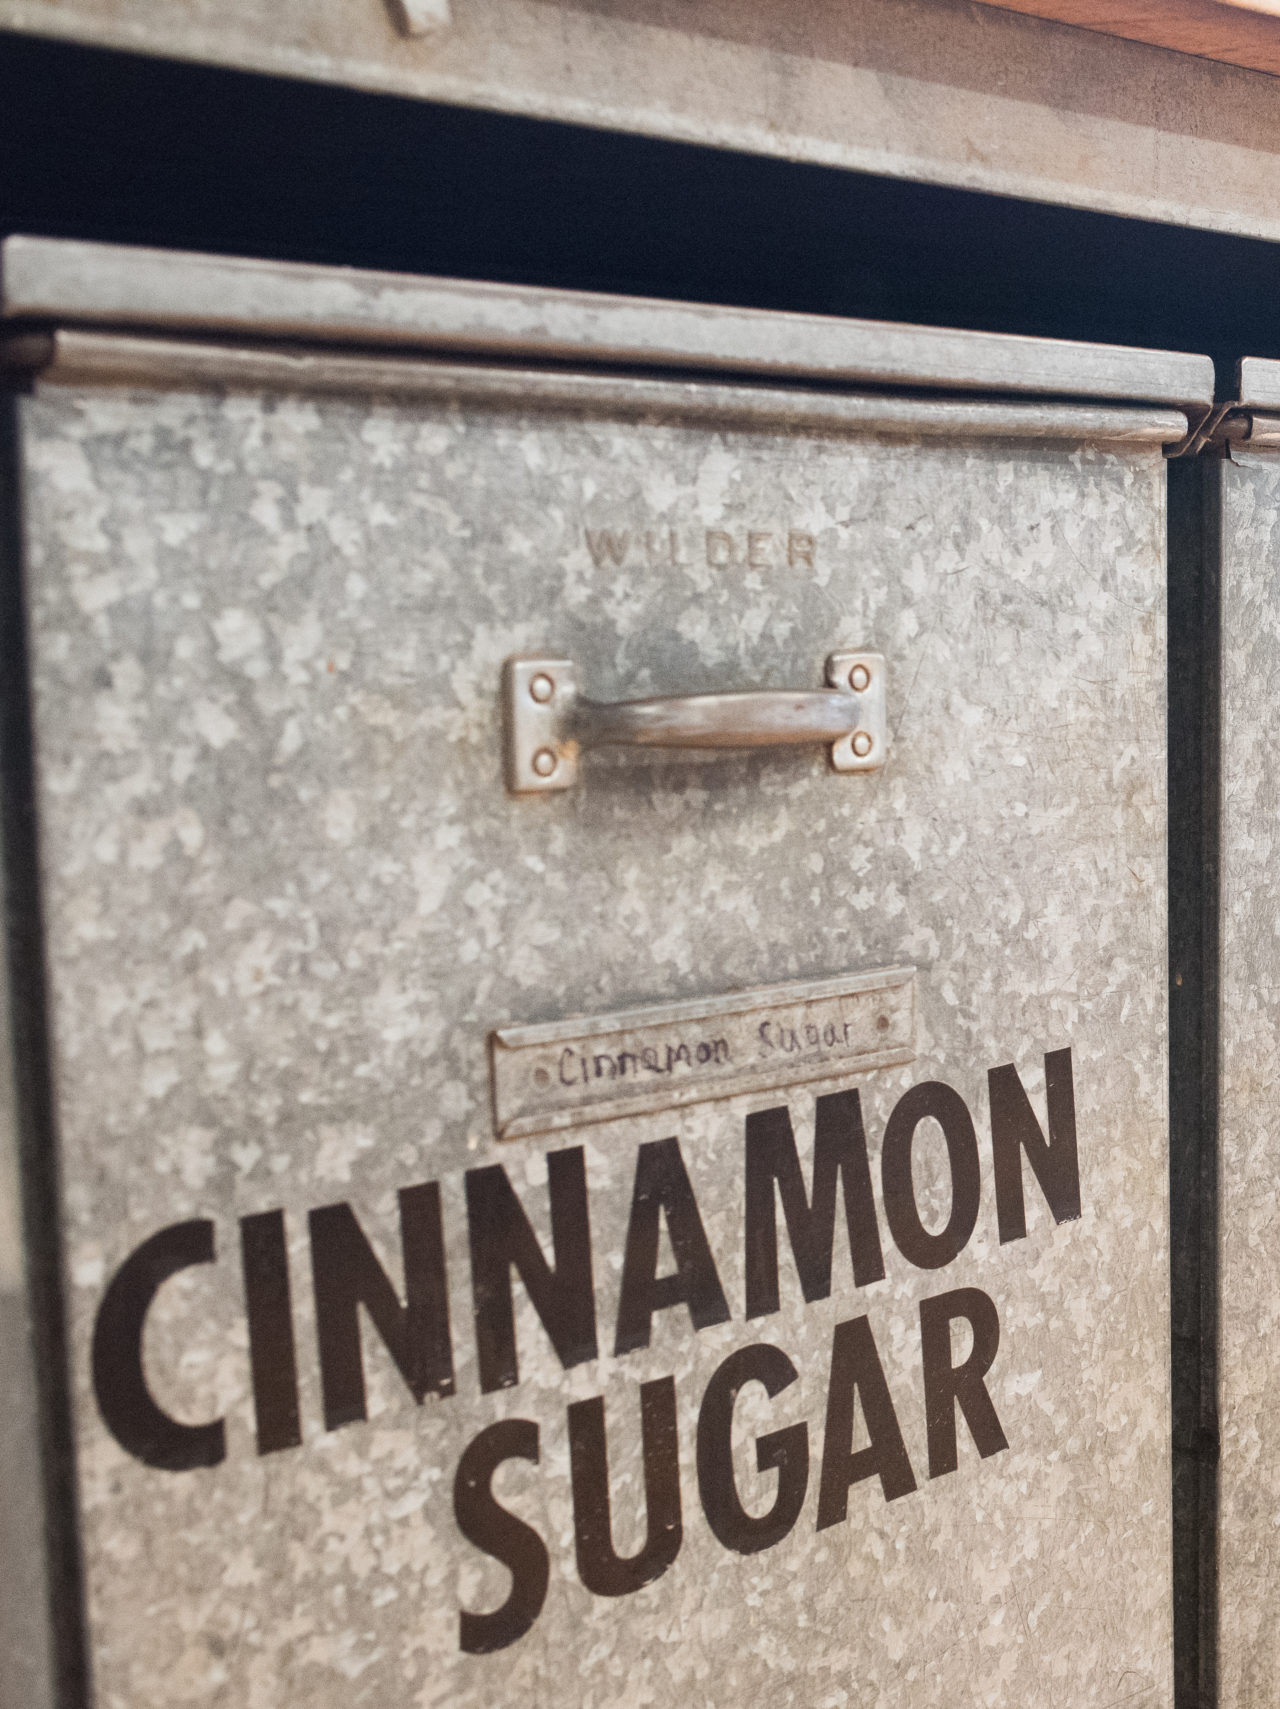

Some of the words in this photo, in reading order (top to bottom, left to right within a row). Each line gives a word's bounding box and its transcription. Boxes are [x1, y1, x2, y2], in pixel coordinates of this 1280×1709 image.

[584, 527, 817, 570] WILDER
[757, 1019, 854, 1059] Sugar
[91, 1047, 1081, 1472] CINNAMON
[453, 1287, 1009, 1655] SUGAR
